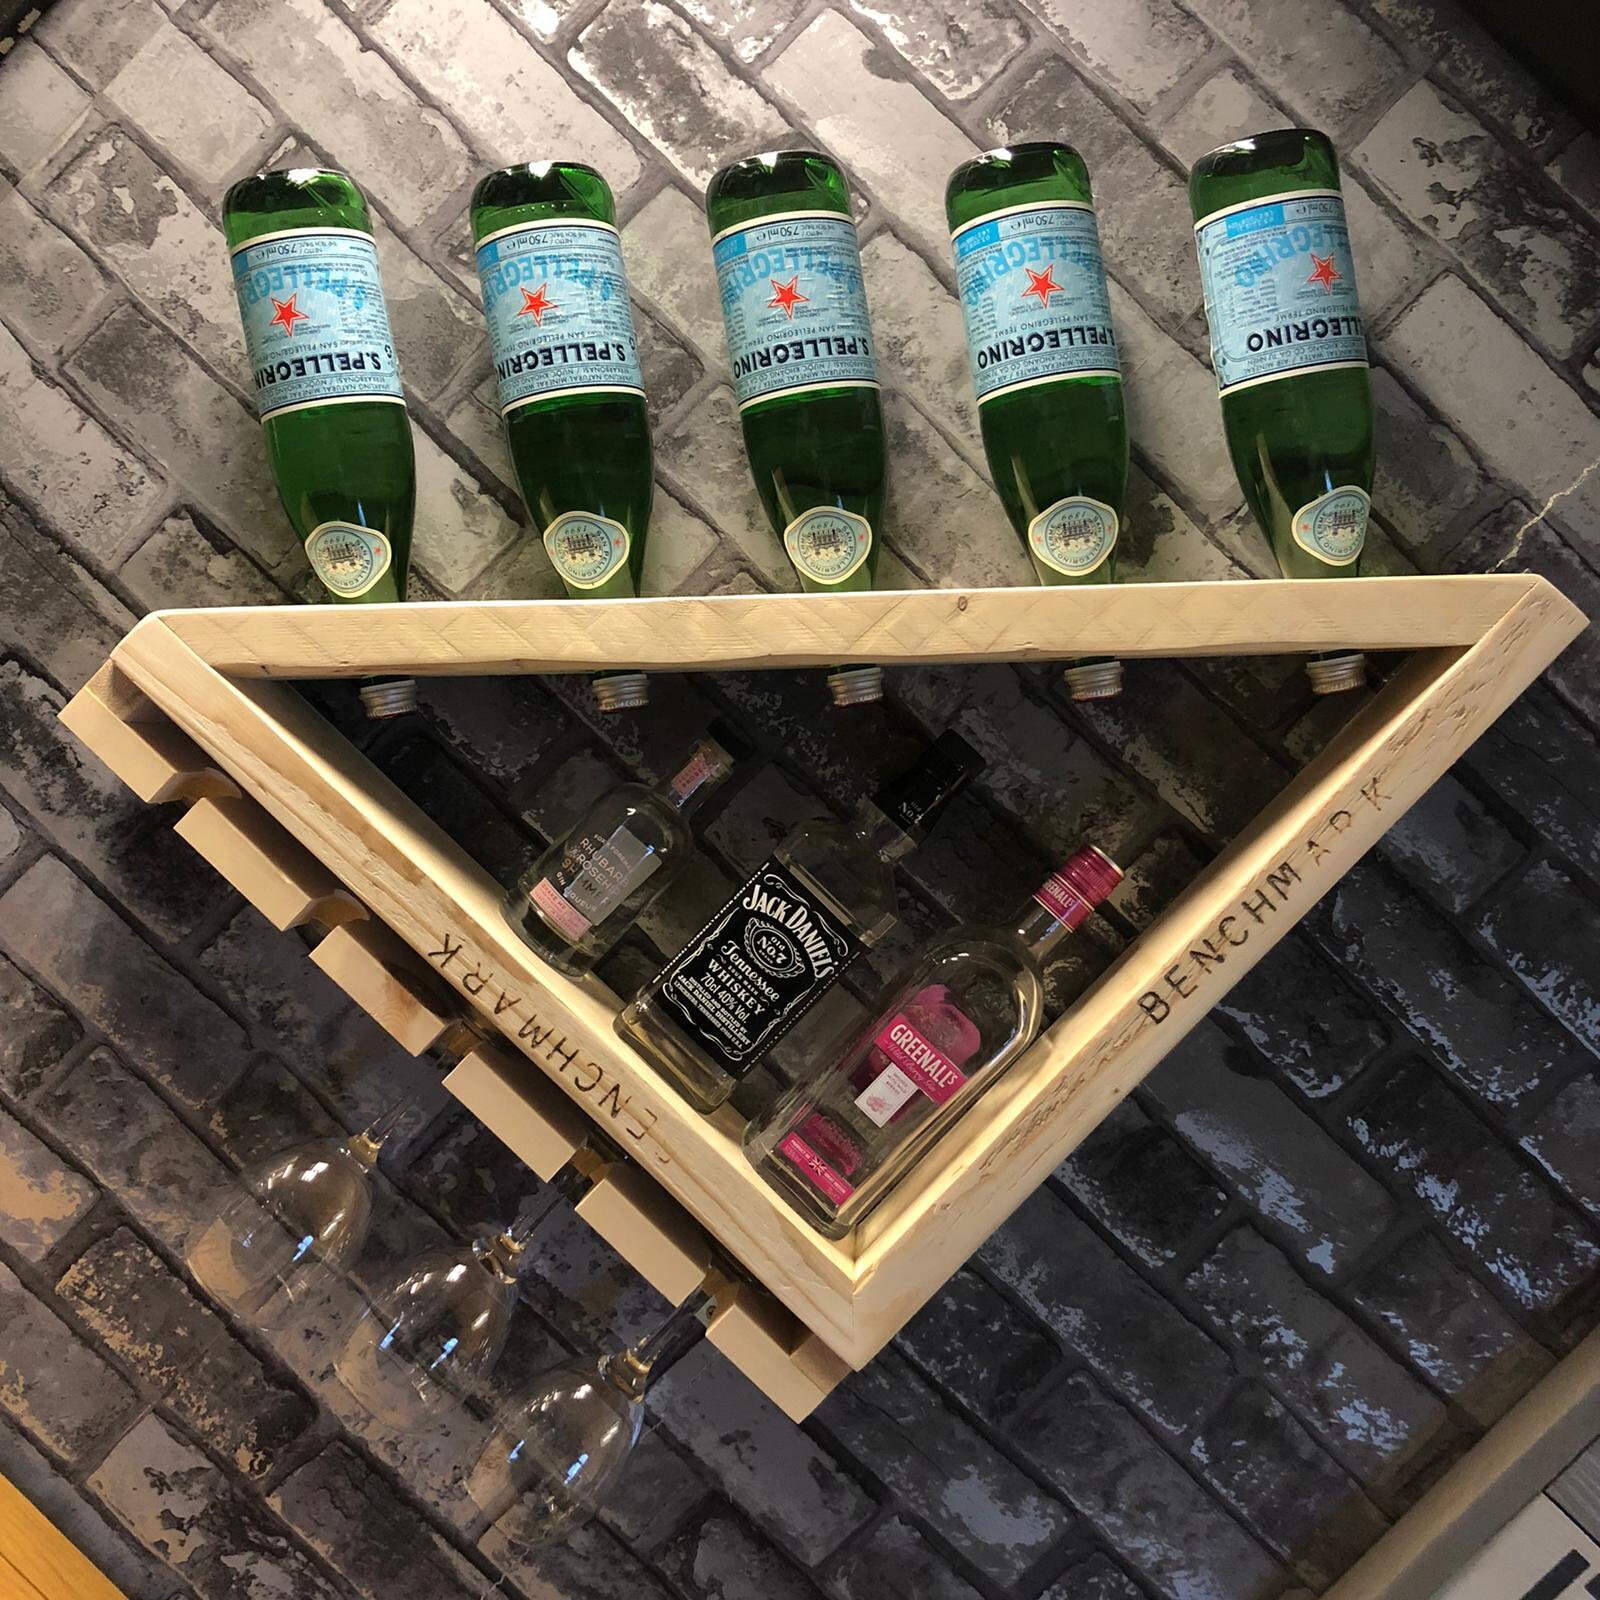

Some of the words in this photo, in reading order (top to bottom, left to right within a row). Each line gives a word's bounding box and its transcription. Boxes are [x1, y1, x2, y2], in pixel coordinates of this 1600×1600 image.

[1020, 315, 1070, 330] PELLEGRINO
[732, 336, 869, 379] S.PELLEGRINO
[555, 870, 566, 885] GIN
[579, 836, 630, 889] RHUBARB
[740, 882, 791, 922] JACK
[755, 934, 787, 965] No.7
[769, 935, 786, 951] Old
[698, 971, 721, 994] 70cl
[715, 987, 738, 1010] 40%
[732, 1004, 752, 1024] Vol.
[704, 958, 766, 1017] WHISKEY
[719, 939, 781, 1003] Tennessee
[676, 973, 695, 991] JACK
[692, 989, 717, 1012] DANIEL
[713, 1010, 751, 1046] DISTILLERY
[427, 931, 673, 1165] ENCHMARK
[888, 1023, 959, 1088] GREENALL'S
